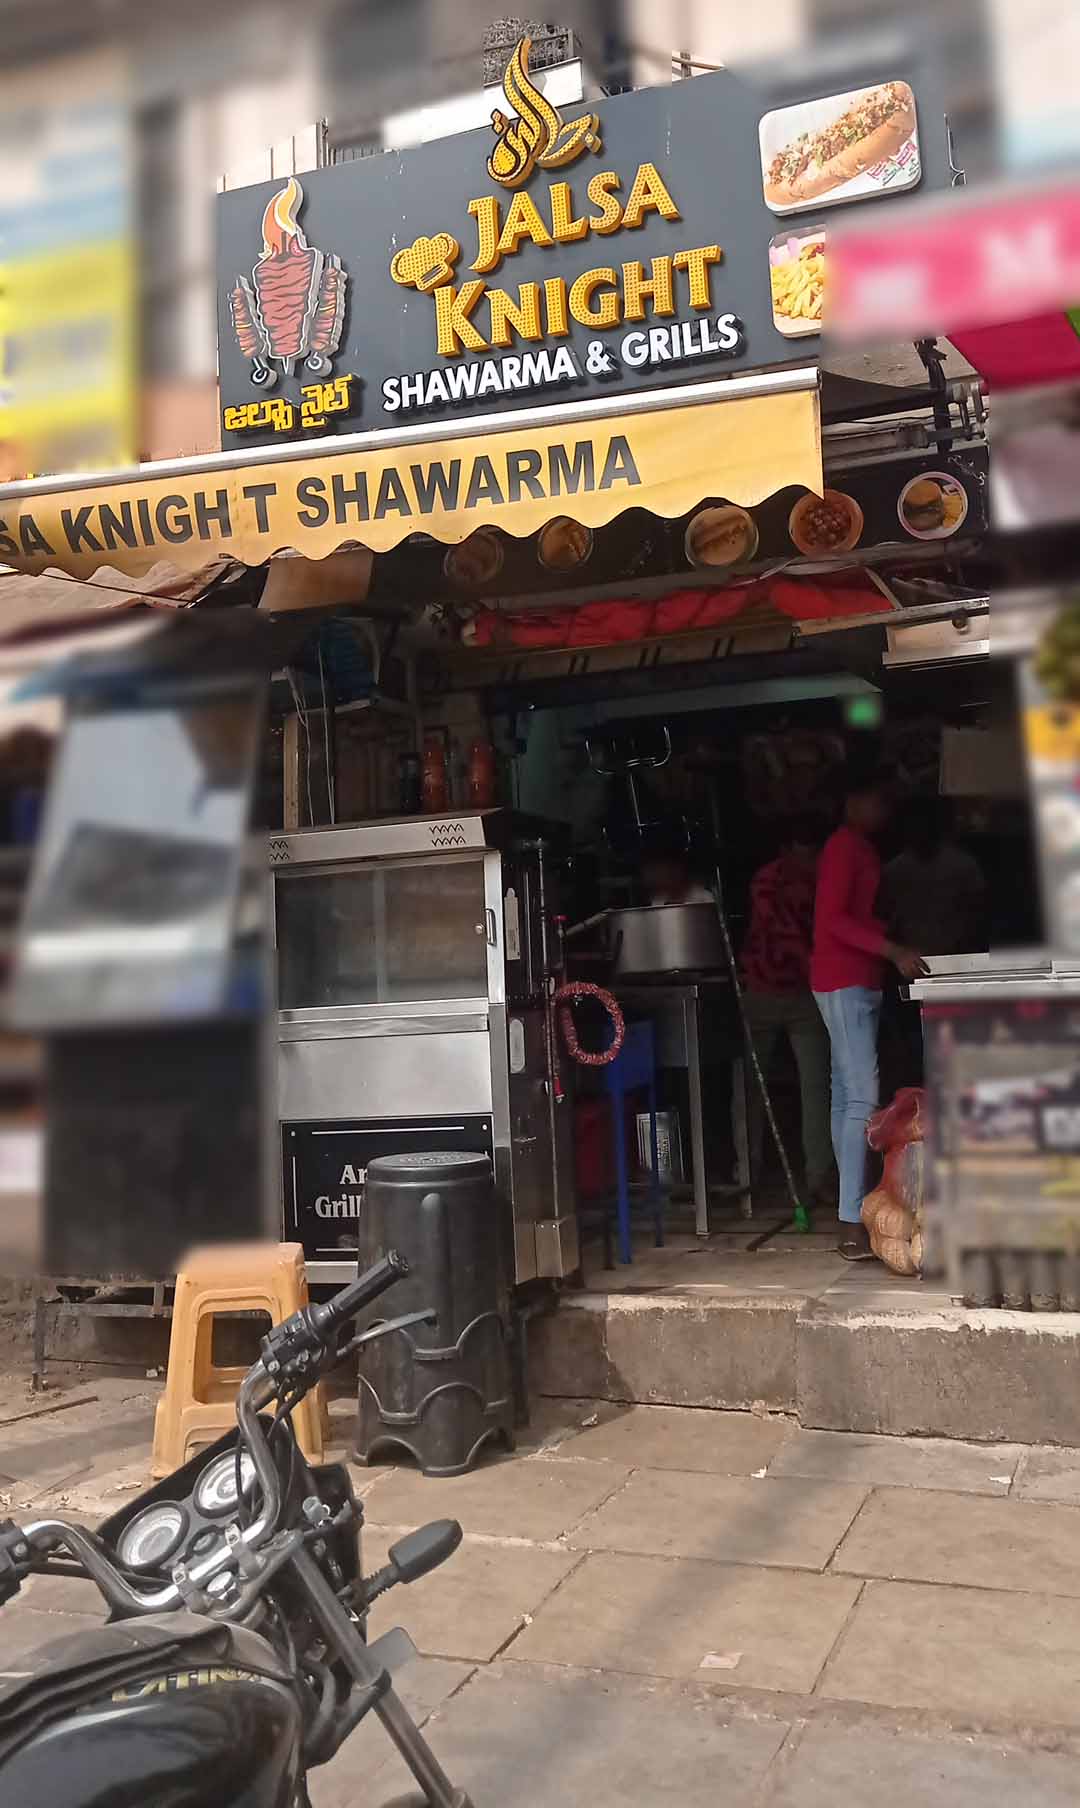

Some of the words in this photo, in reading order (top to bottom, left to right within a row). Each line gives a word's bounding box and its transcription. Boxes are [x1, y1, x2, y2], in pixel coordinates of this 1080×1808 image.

[467, 162, 679, 273] JALSA
[434, 245, 722, 357] KNIGHT
[300, 372, 353, 429] నైట్
[382, 346, 579, 412] SHAWARMA
[585, 340, 612, 375] &
[621, 313, 740, 368] GRILLS
[296, 434, 642, 528] SHAWARMA
